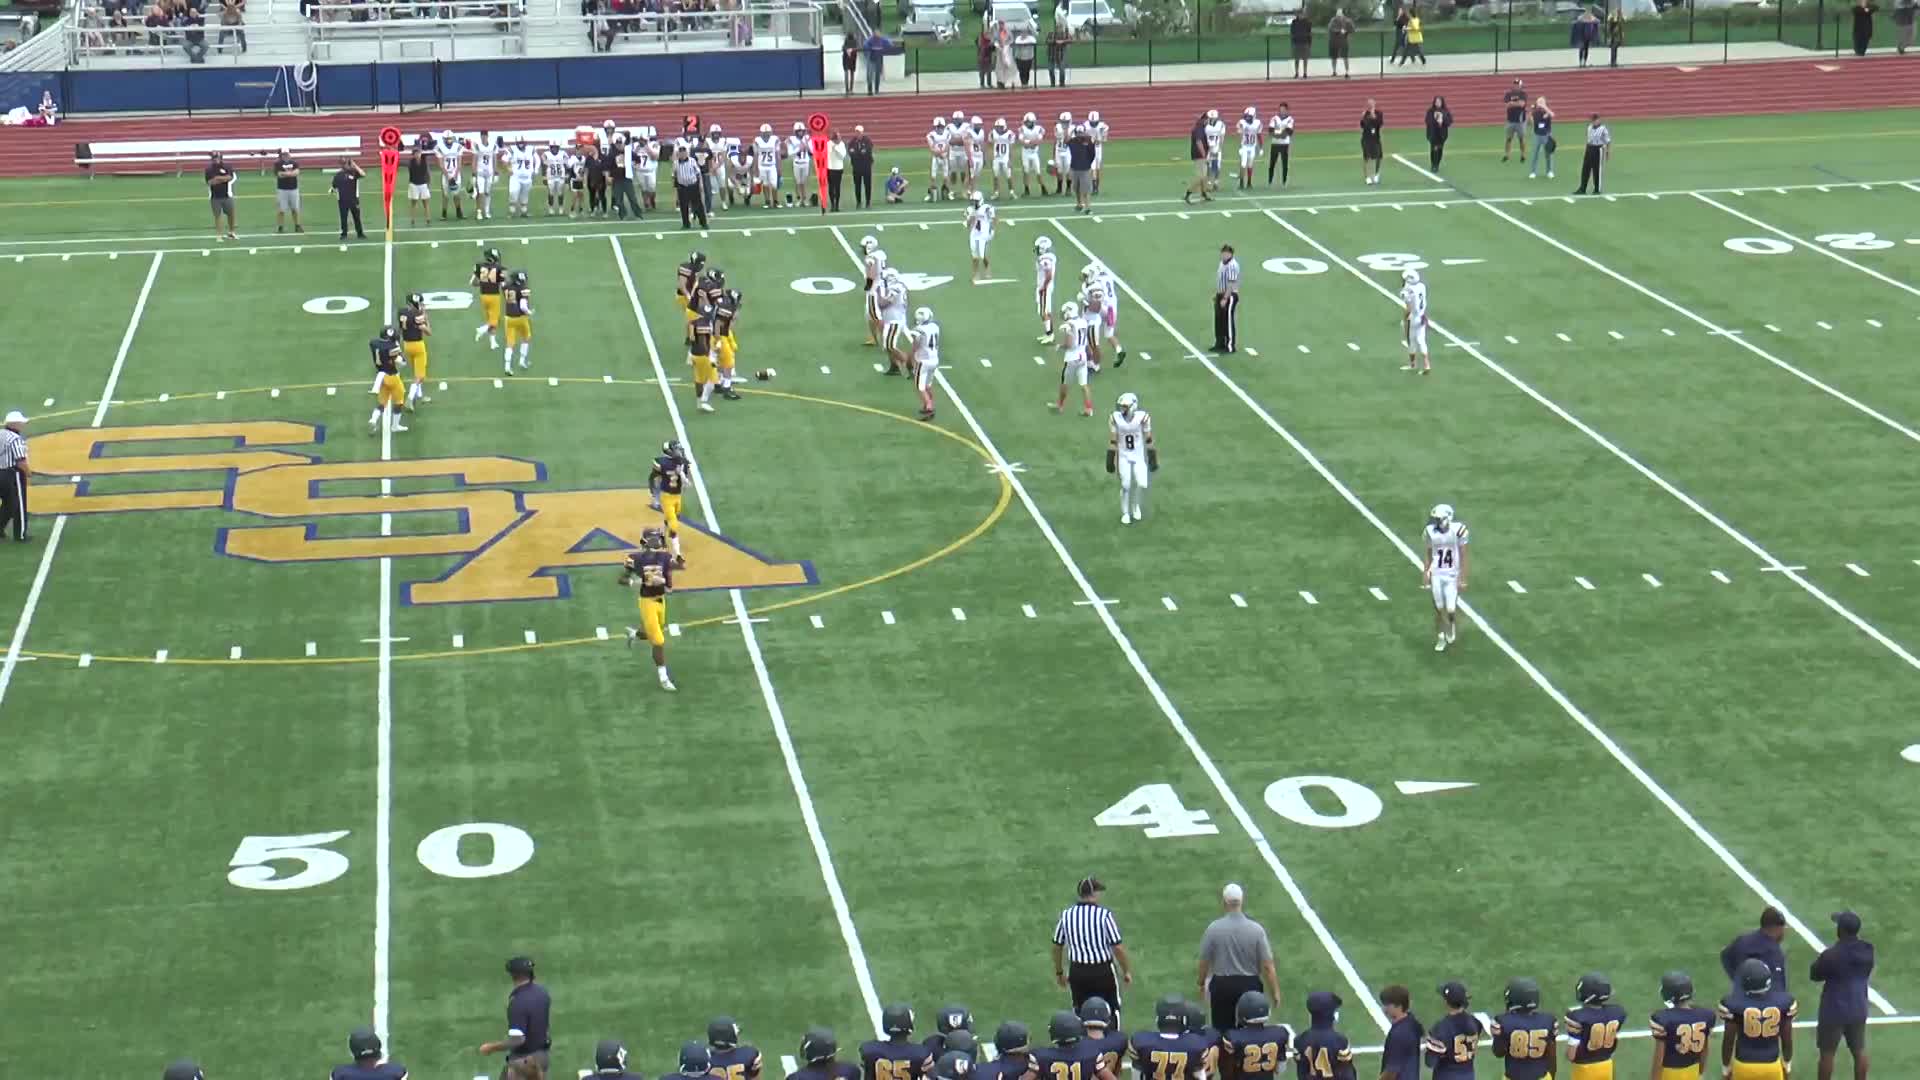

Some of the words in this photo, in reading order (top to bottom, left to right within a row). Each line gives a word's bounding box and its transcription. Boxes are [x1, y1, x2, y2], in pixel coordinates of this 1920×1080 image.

[686, 114, 698, 132] 2
[761, 151, 773, 162] 75
[1437, 549, 1453, 569] 14
[1743, 1006, 1781, 1038] 62
[1509, 1028, 1549, 1059] 85
[1675, 1021, 1707, 1055] 35
[1151, 1051, 1188, 1080] 77
[1243, 1041, 1279, 1073] 23
